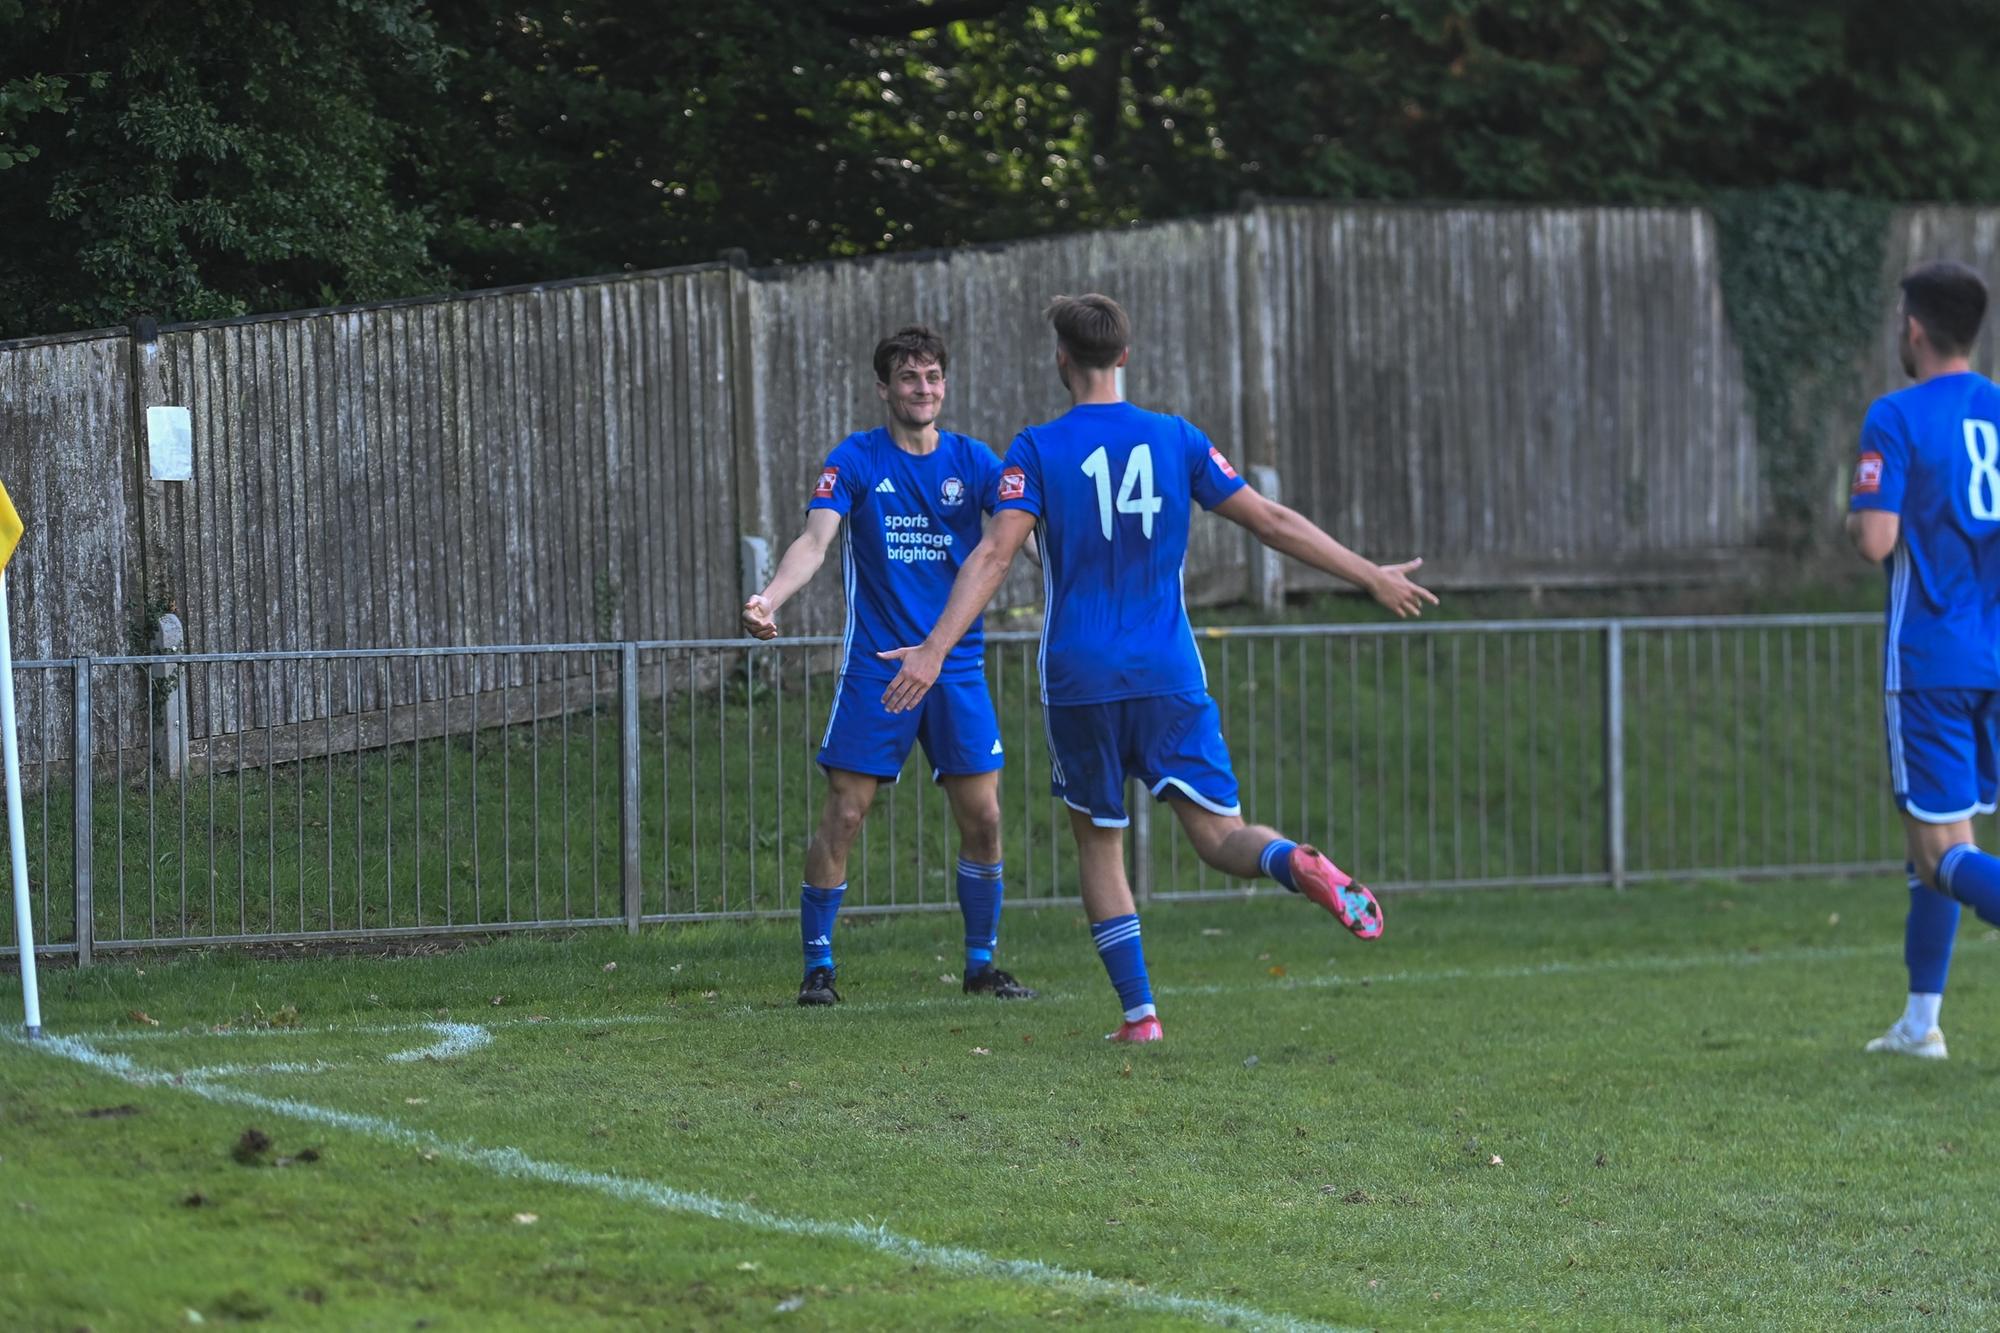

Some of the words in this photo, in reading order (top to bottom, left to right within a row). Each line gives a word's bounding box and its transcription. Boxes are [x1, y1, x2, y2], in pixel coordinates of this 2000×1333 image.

[1962, 418, 2000, 521] 8
[1080, 443, 1163, 542] 14
[885, 514, 929, 530] sports
[886, 532, 953, 548] massage
[888, 546, 947, 564] brighton
